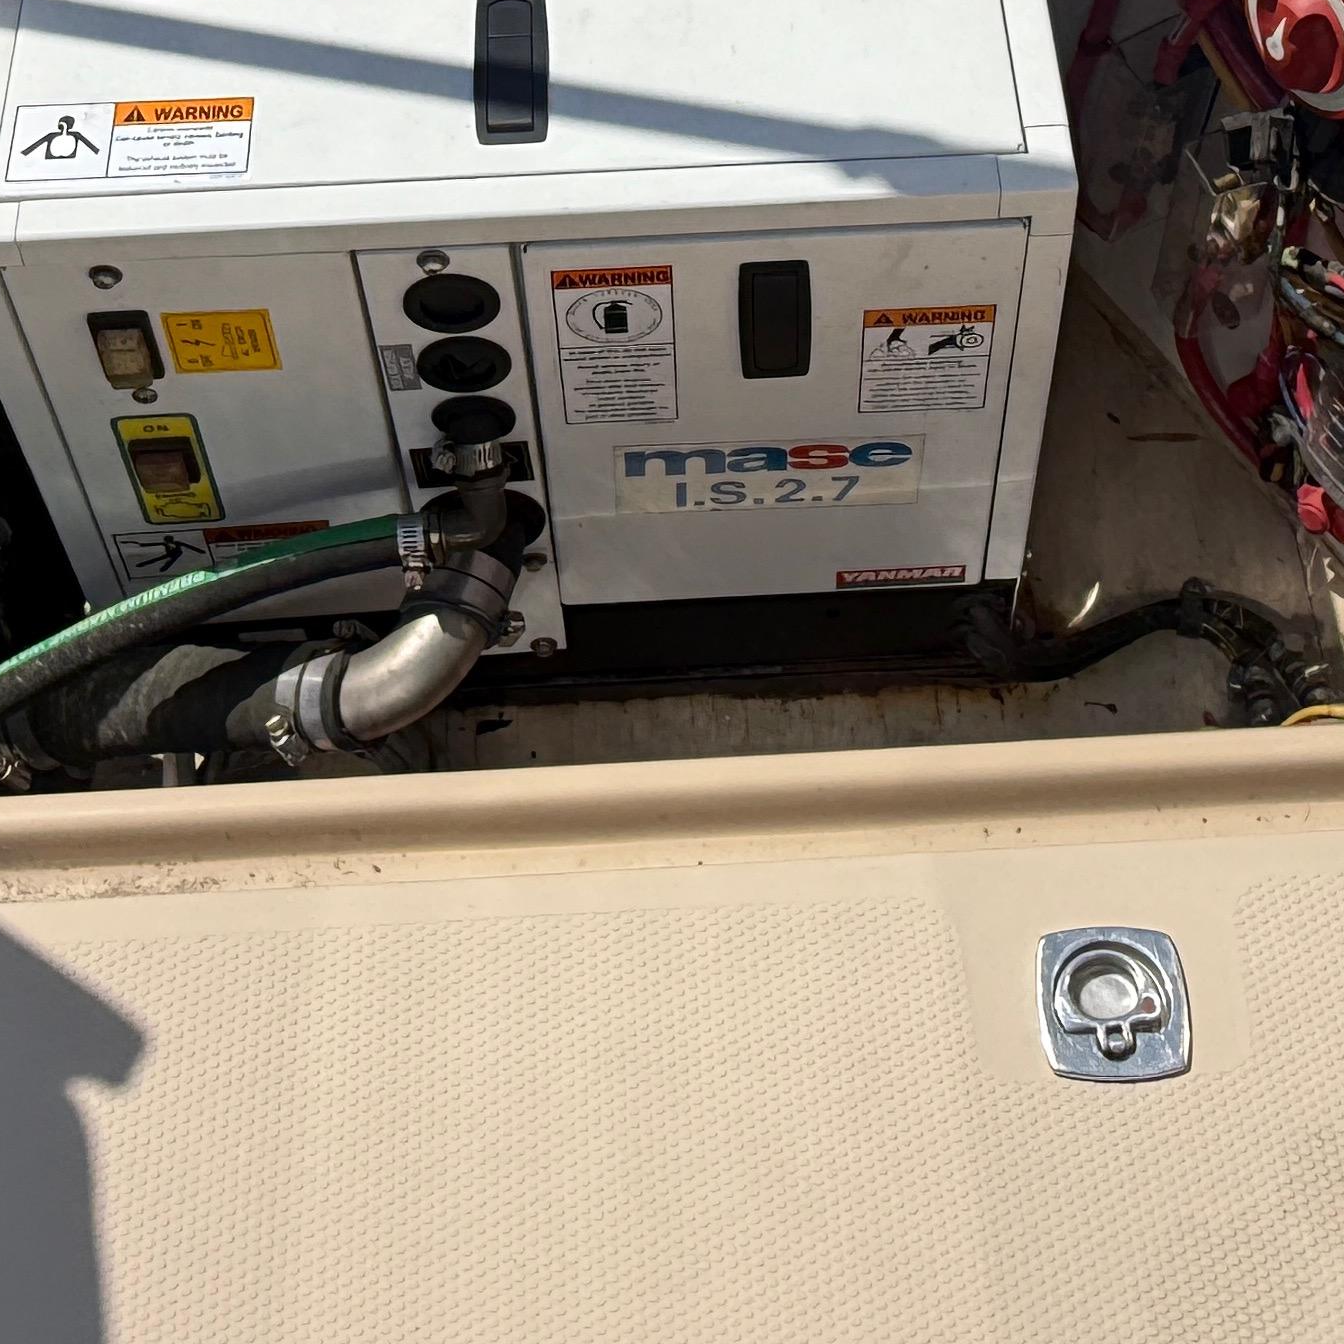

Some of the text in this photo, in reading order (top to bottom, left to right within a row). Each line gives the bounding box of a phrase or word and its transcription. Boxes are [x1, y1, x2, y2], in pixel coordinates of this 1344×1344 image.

[154, 104, 244, 122] WARNING
[578, 269, 670, 286] WARNING
[901, 309, 987, 325] WARNING
[142, 424, 170, 433] ON
[623, 440, 913, 478] mase
[840, 565, 964, 584] YANMAR
